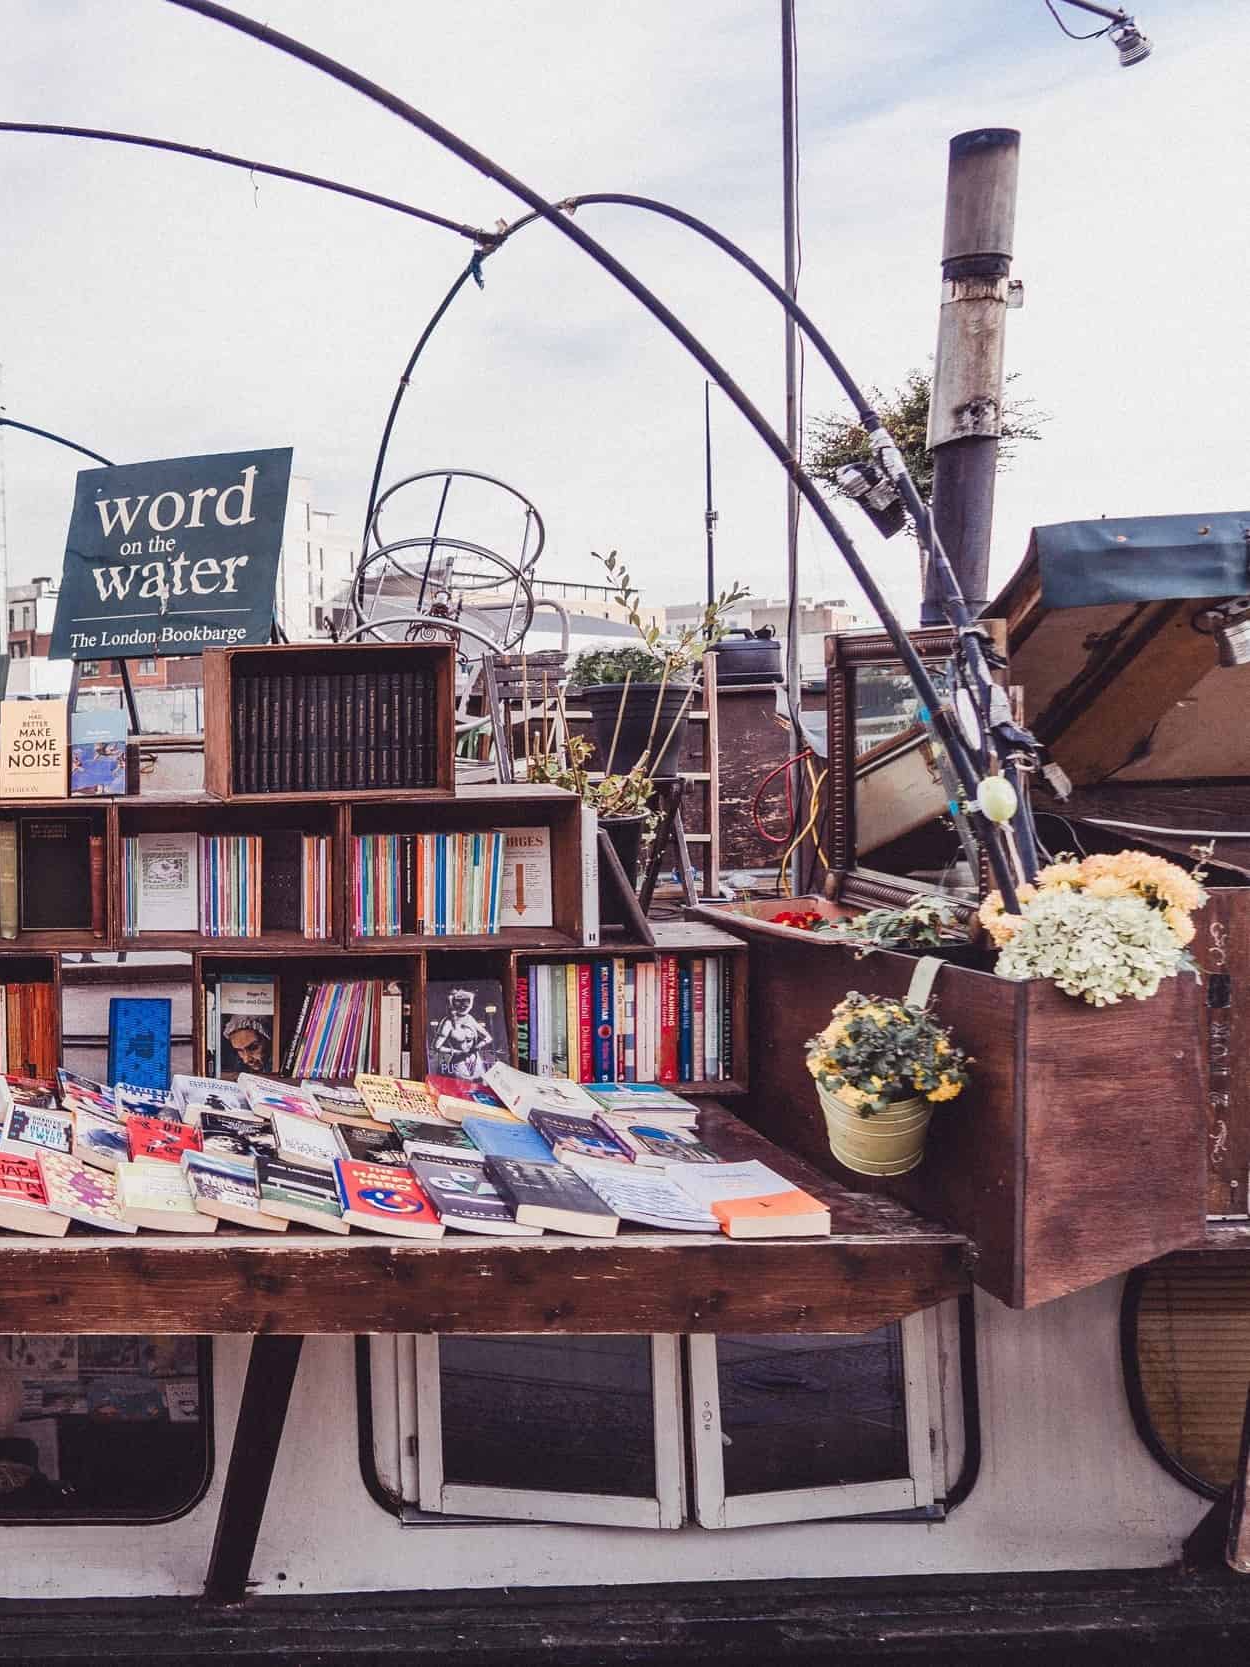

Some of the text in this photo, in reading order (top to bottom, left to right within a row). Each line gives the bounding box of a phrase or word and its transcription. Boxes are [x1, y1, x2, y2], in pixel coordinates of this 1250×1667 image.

[95, 465, 259, 537] word
[120, 535, 176, 556] on the
[93, 552, 249, 602] water
[70, 626, 247, 649] The London Bookbarge
[19, 728, 52, 737] MAKE
[13, 738, 57, 752] SOME
[8, 753, 62, 768] NOISE
[352, 1170, 413, 1185] HAPPY
[368, 1167, 395, 1175] THE
[358, 1178, 412, 1192] HERO
